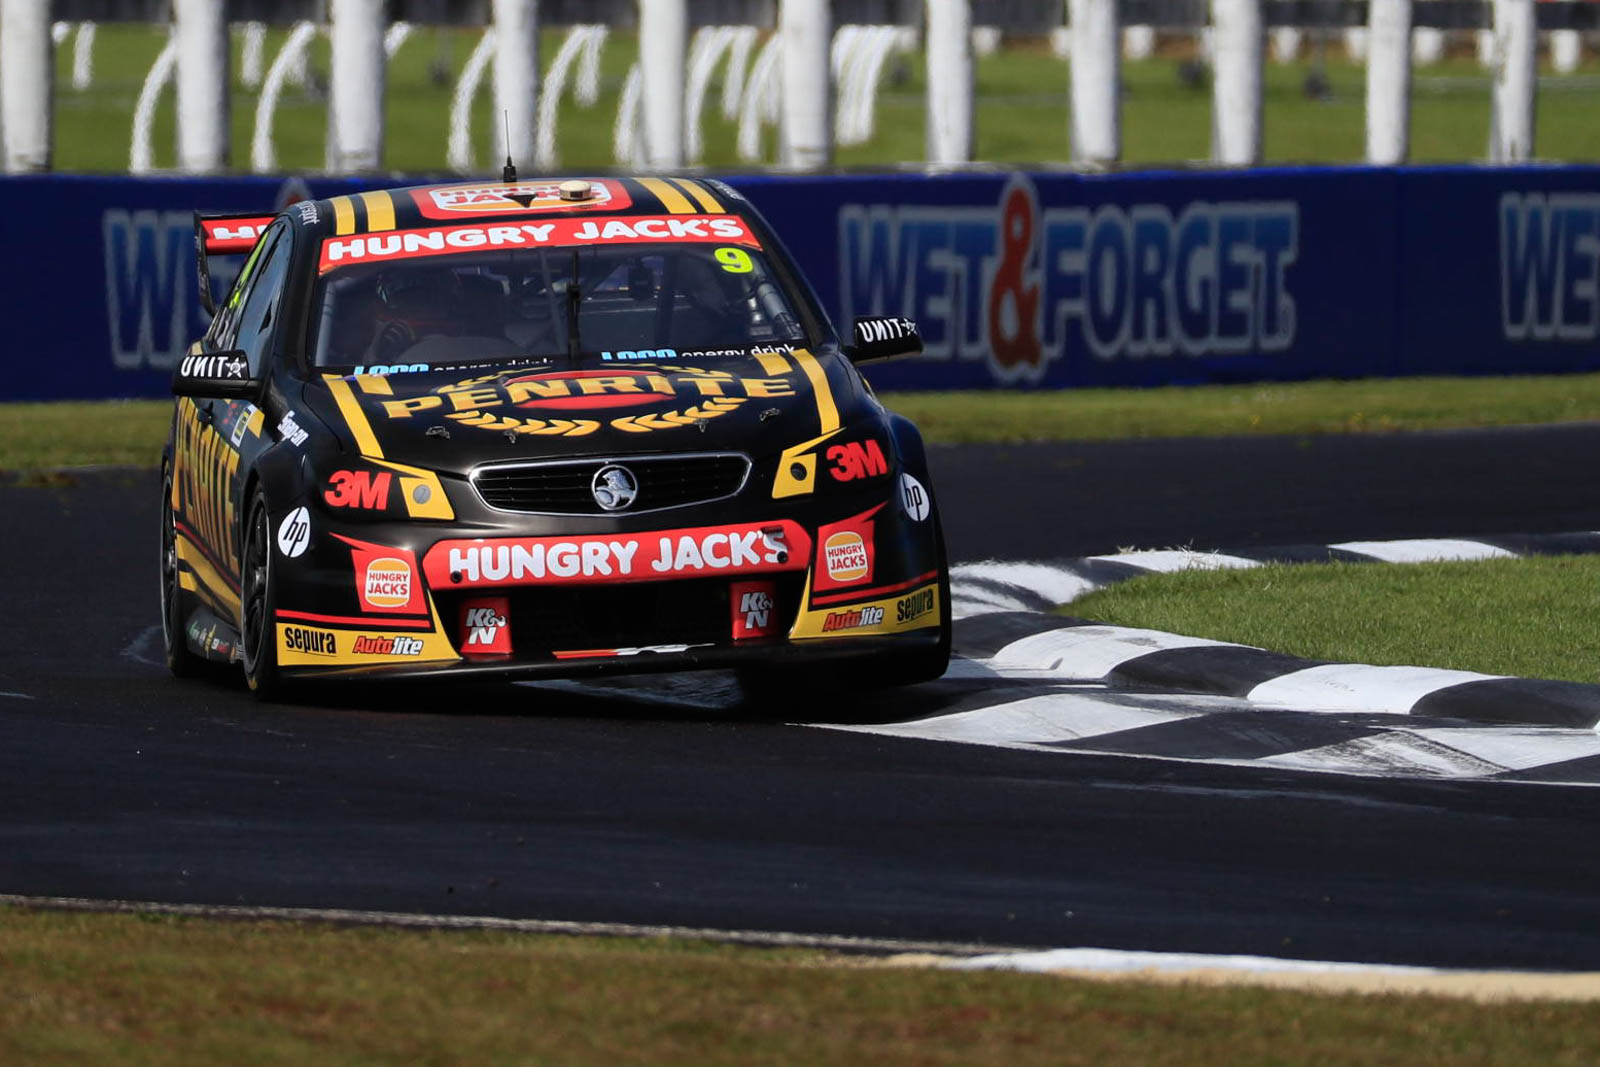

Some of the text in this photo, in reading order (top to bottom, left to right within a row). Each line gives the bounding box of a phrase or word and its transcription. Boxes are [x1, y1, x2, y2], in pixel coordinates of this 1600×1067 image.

[327, 218, 744, 261] HUNGRY JACK'S
[714, 247, 753, 273] 9
[380, 374, 797, 420] PENRITE
[827, 438, 888, 482] 3M
[323, 470, 393, 511] 3M
[449, 529, 789, 582] HUNGRY JACK'S
[827, 544, 863, 558] HUNGRY
[367, 571, 410, 583] HUNGRY
[822, 588, 935, 632] Autolite sepura
[284, 626, 424, 656] sepura Autolite
